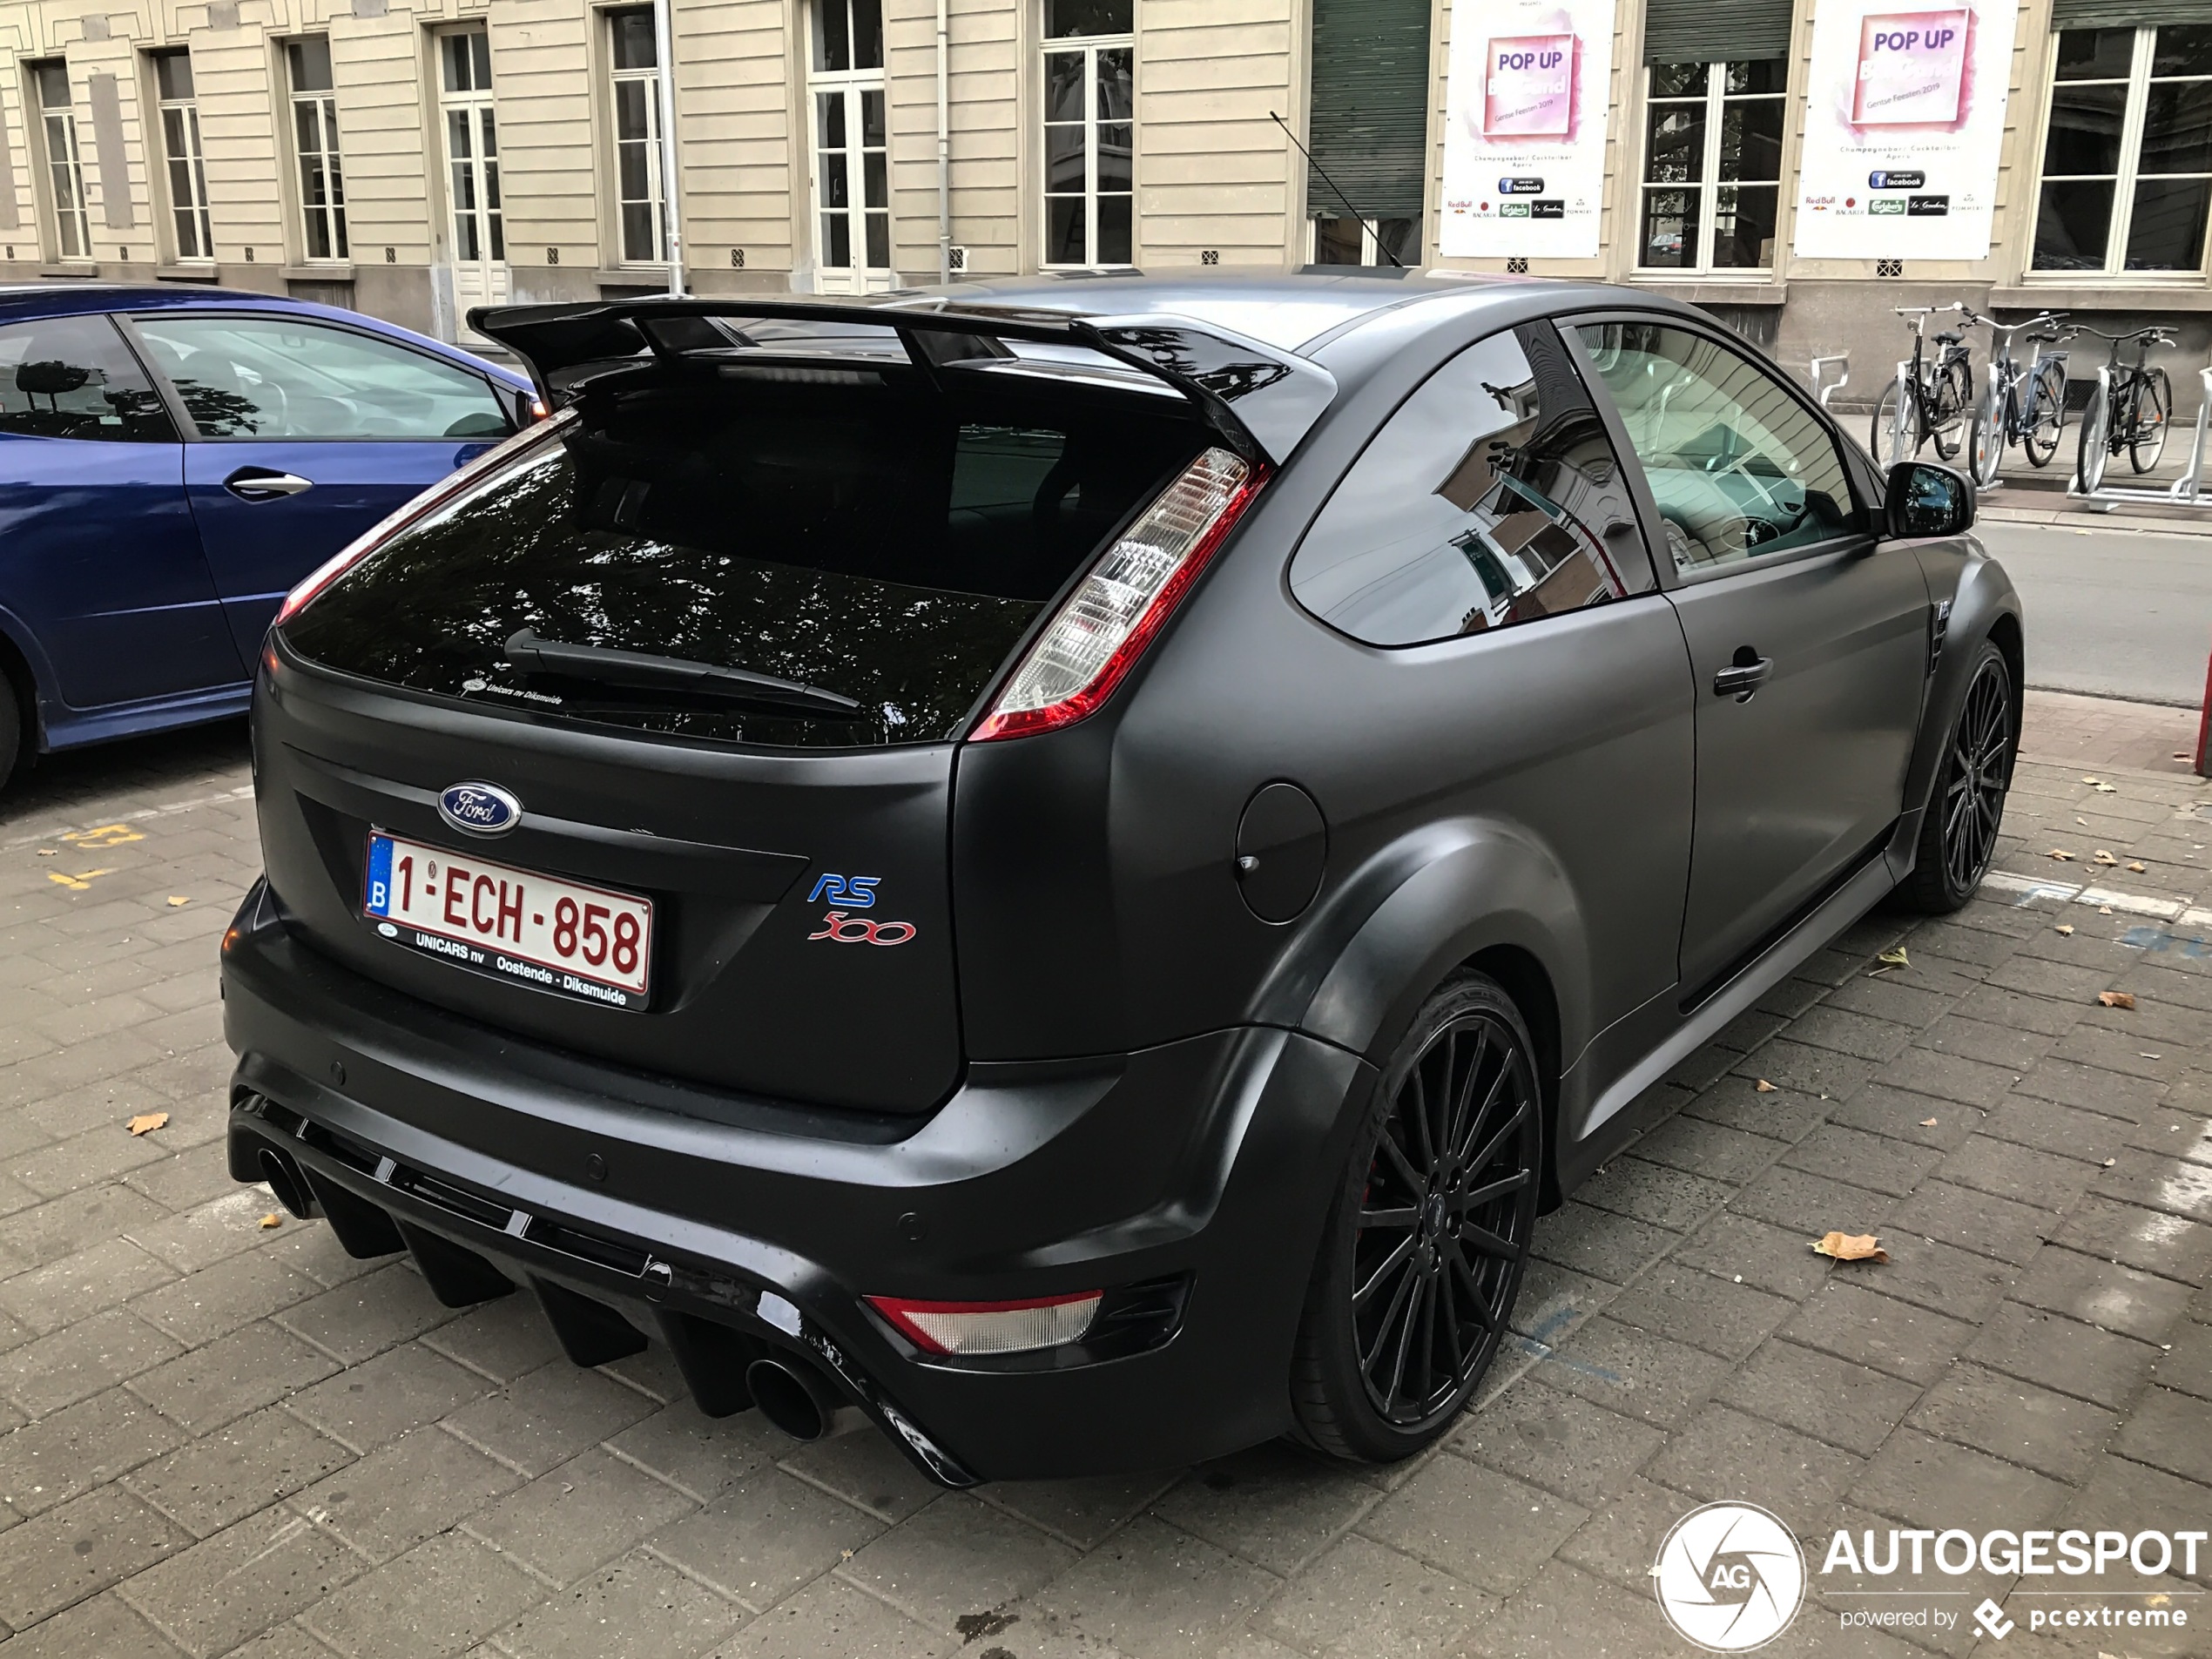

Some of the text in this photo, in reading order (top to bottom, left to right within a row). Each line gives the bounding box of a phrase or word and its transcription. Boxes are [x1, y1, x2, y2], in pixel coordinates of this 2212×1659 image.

[1874, 29, 1954, 51] POP UP
[1499, 51, 1562, 71] POP UP
[1866, 82, 1940, 109] Gentse Feesten 2019
[1494, 98, 1554, 123] Gentse Feesten 2019
[1501, 204, 1527, 216] Carlsberg
[1871, 200, 1903, 214] Carlsberg
[487, 684, 514, 696] Unicars
[523, 691, 563, 705] Diksmuide
[454, 790, 496, 822] Ford
[371, 880, 387, 907] B
[807, 873, 881, 908] RS
[399, 856, 640, 974] 1-ECH-858
[807, 911, 916, 946] 500
[415, 933, 469, 959] UNICARS
[470, 951, 485, 964] nv
[496, 956, 553, 984] Oostende
[563, 974, 626, 1006] Diksmuide
